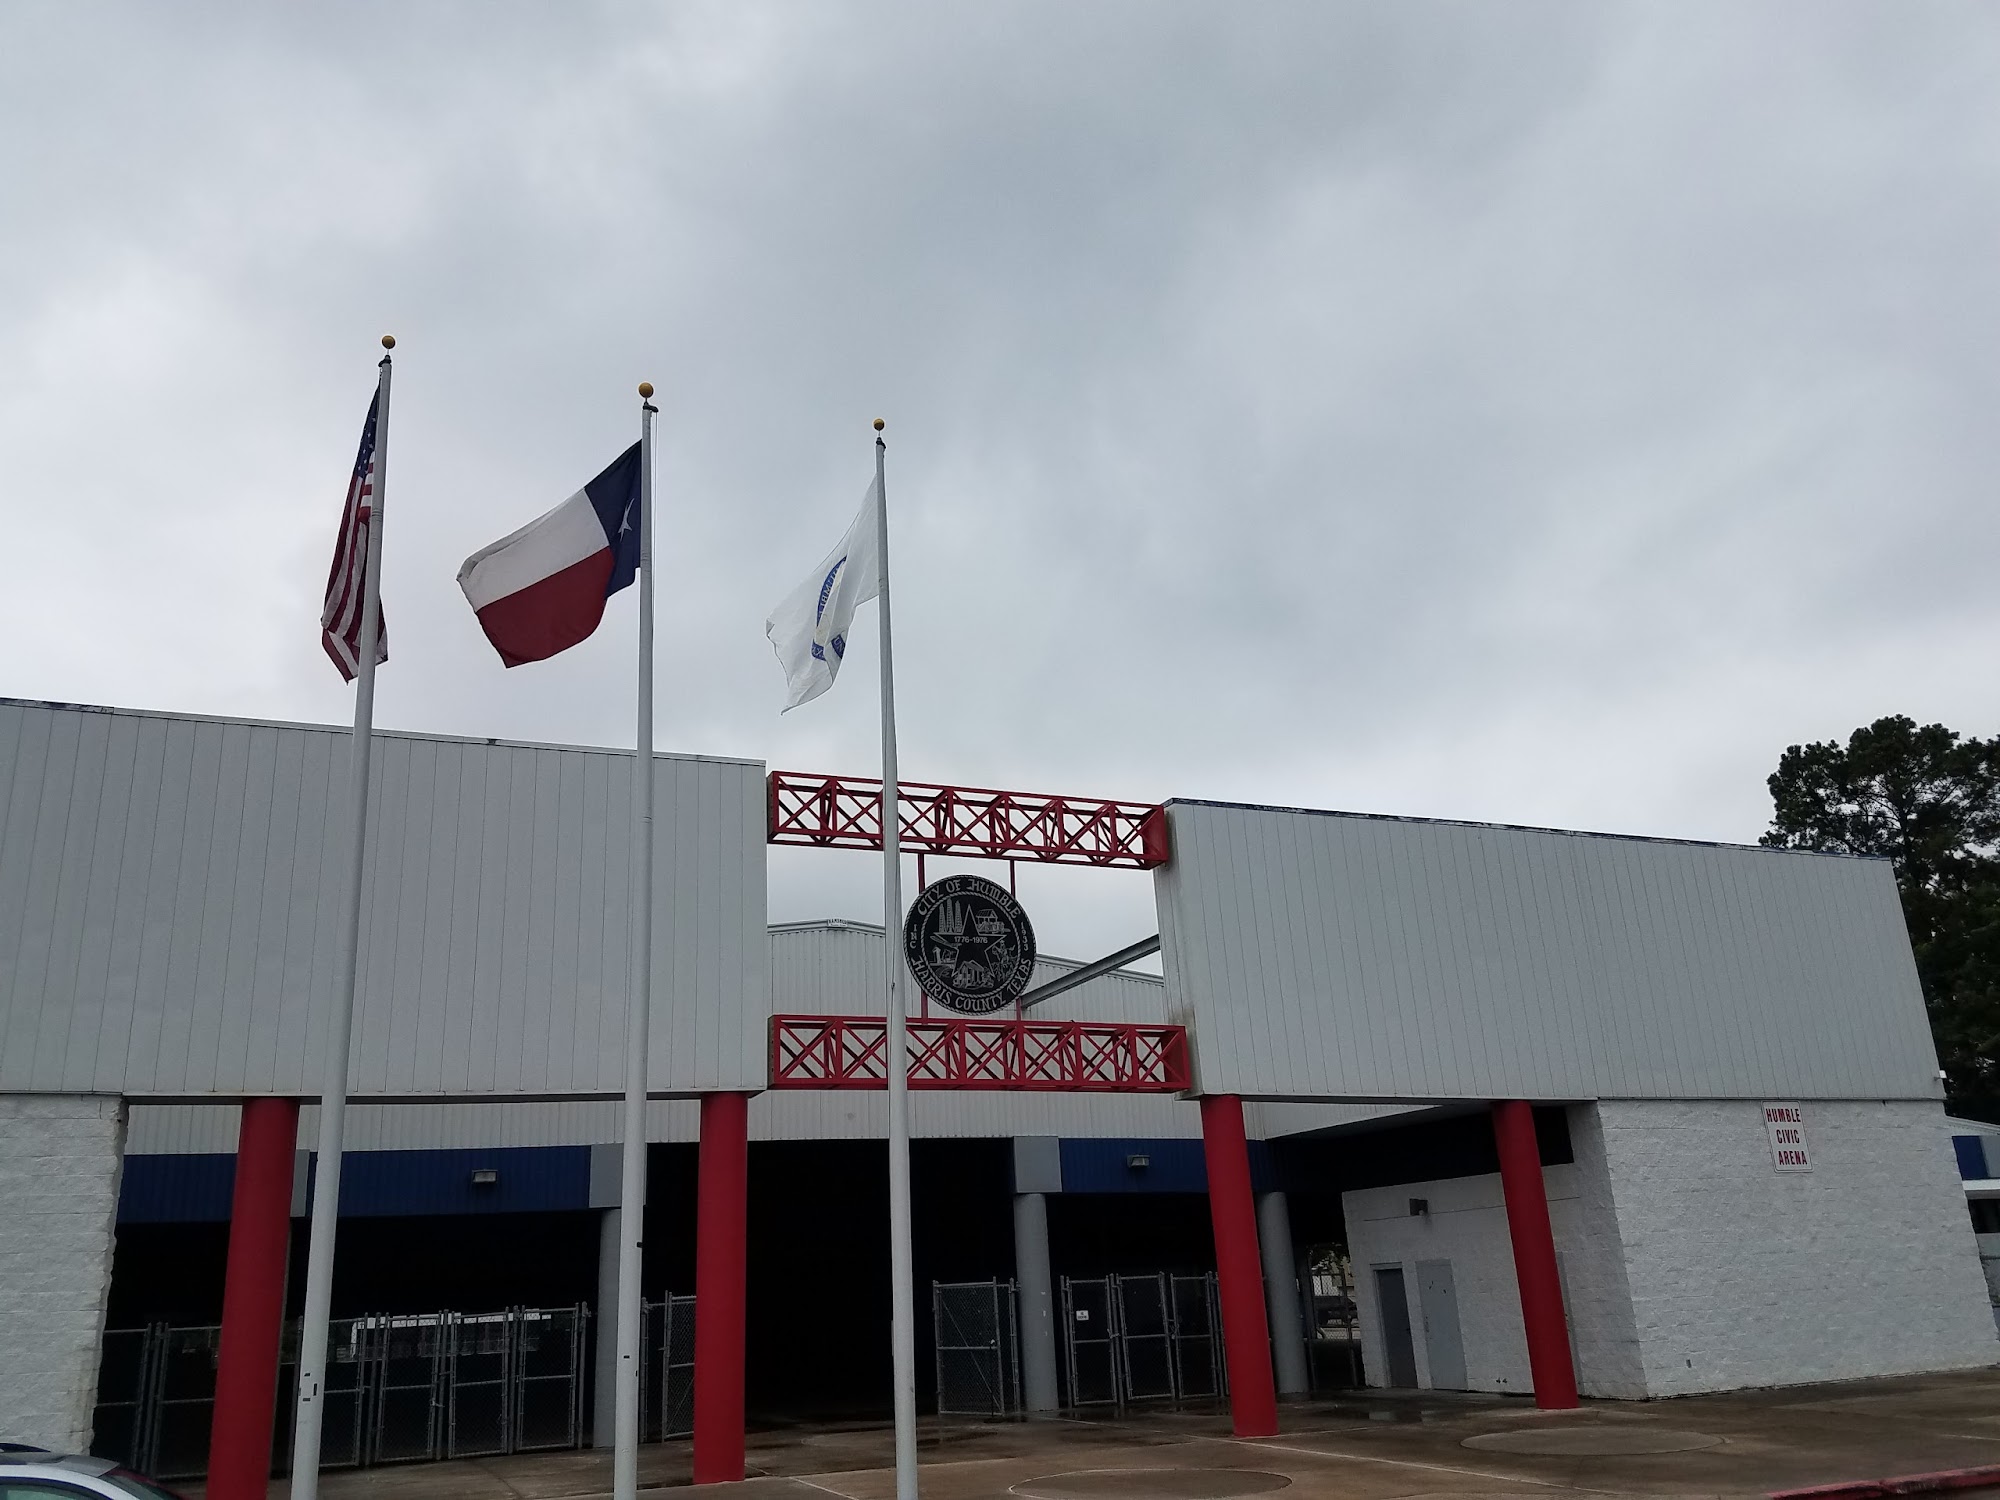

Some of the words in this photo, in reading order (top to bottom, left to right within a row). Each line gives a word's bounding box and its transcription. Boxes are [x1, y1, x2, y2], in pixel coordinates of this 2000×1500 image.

[917, 884, 944, 916] CITY
[945, 878, 961, 894] OF
[966, 878, 1021, 919] HUMBLE
[909, 923, 918, 949] INC
[953, 935, 988, 944] 1776-1976
[1020, 921, 1029, 951] 1933
[911, 955, 952, 1005] HARRIS
[955, 993, 1007, 1012] COUNTY
[1006, 958, 1032, 995] TEXAS
[1765, 1108, 1801, 1123] HUMBLE
[1776, 1129, 1800, 1144] CIVIC
[1778, 1150, 1807, 1165] ARENA
